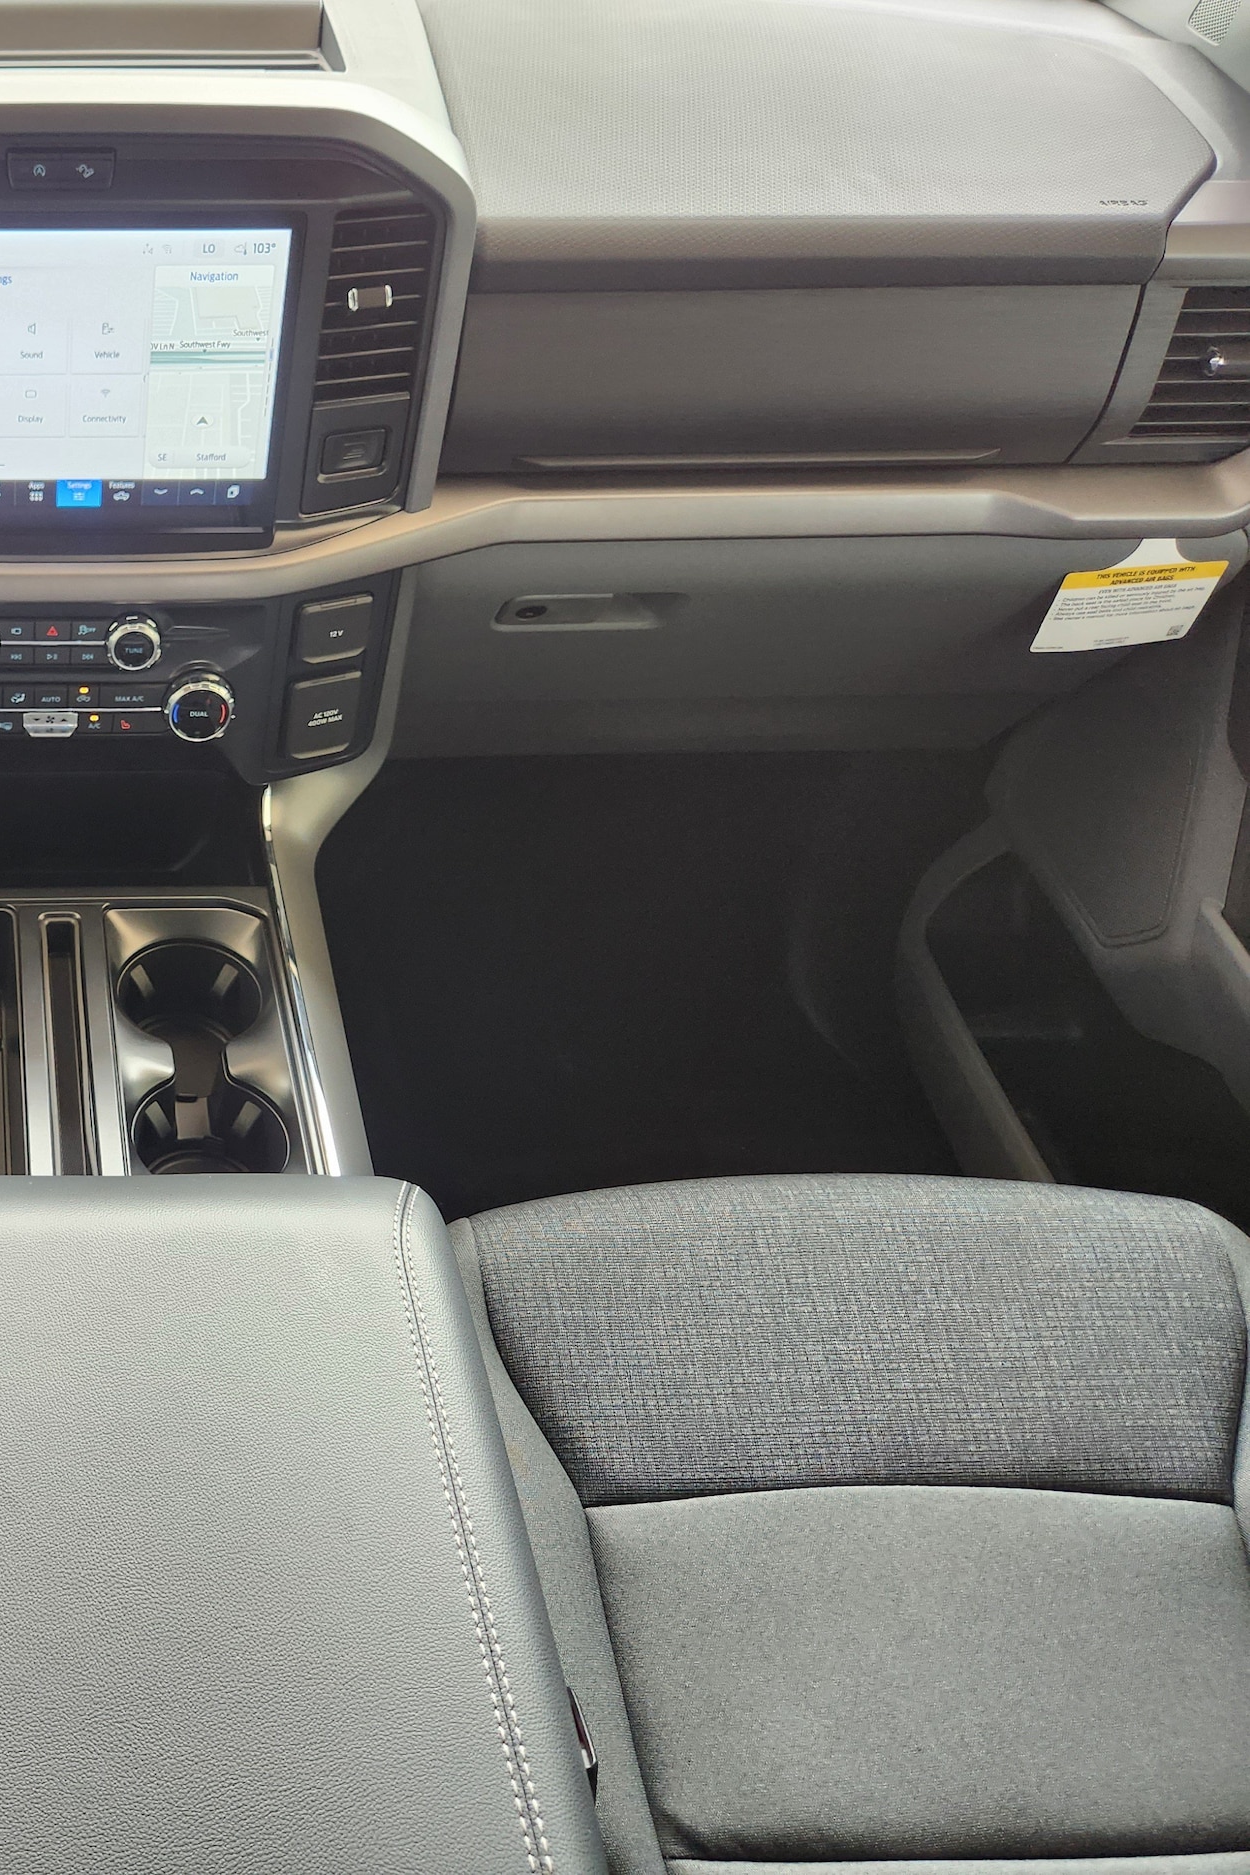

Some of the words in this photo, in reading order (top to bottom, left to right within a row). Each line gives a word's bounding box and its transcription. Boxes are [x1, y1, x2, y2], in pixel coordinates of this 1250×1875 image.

[202, 244, 216, 254] LO
[253, 242, 276, 254] 103°
[190, 272, 238, 282] Navigation
[160, 342, 168, 350] Ln
[168, 342, 174, 350] N
[217, 341, 231, 349] Fwy
[20, 351, 43, 359] Sound
[94, 351, 120, 359] Vehicle
[18, 415, 43, 424] Display
[83, 415, 126, 424] Connectivity
[28, 482, 45, 490] Apps
[67, 481, 91, 490] Settings
[109, 481, 135, 490] Features
[1112, 571, 1136, 579] VEHICLE
[307, 718, 328, 726] 400W
[328, 714, 342, 723] MAX
